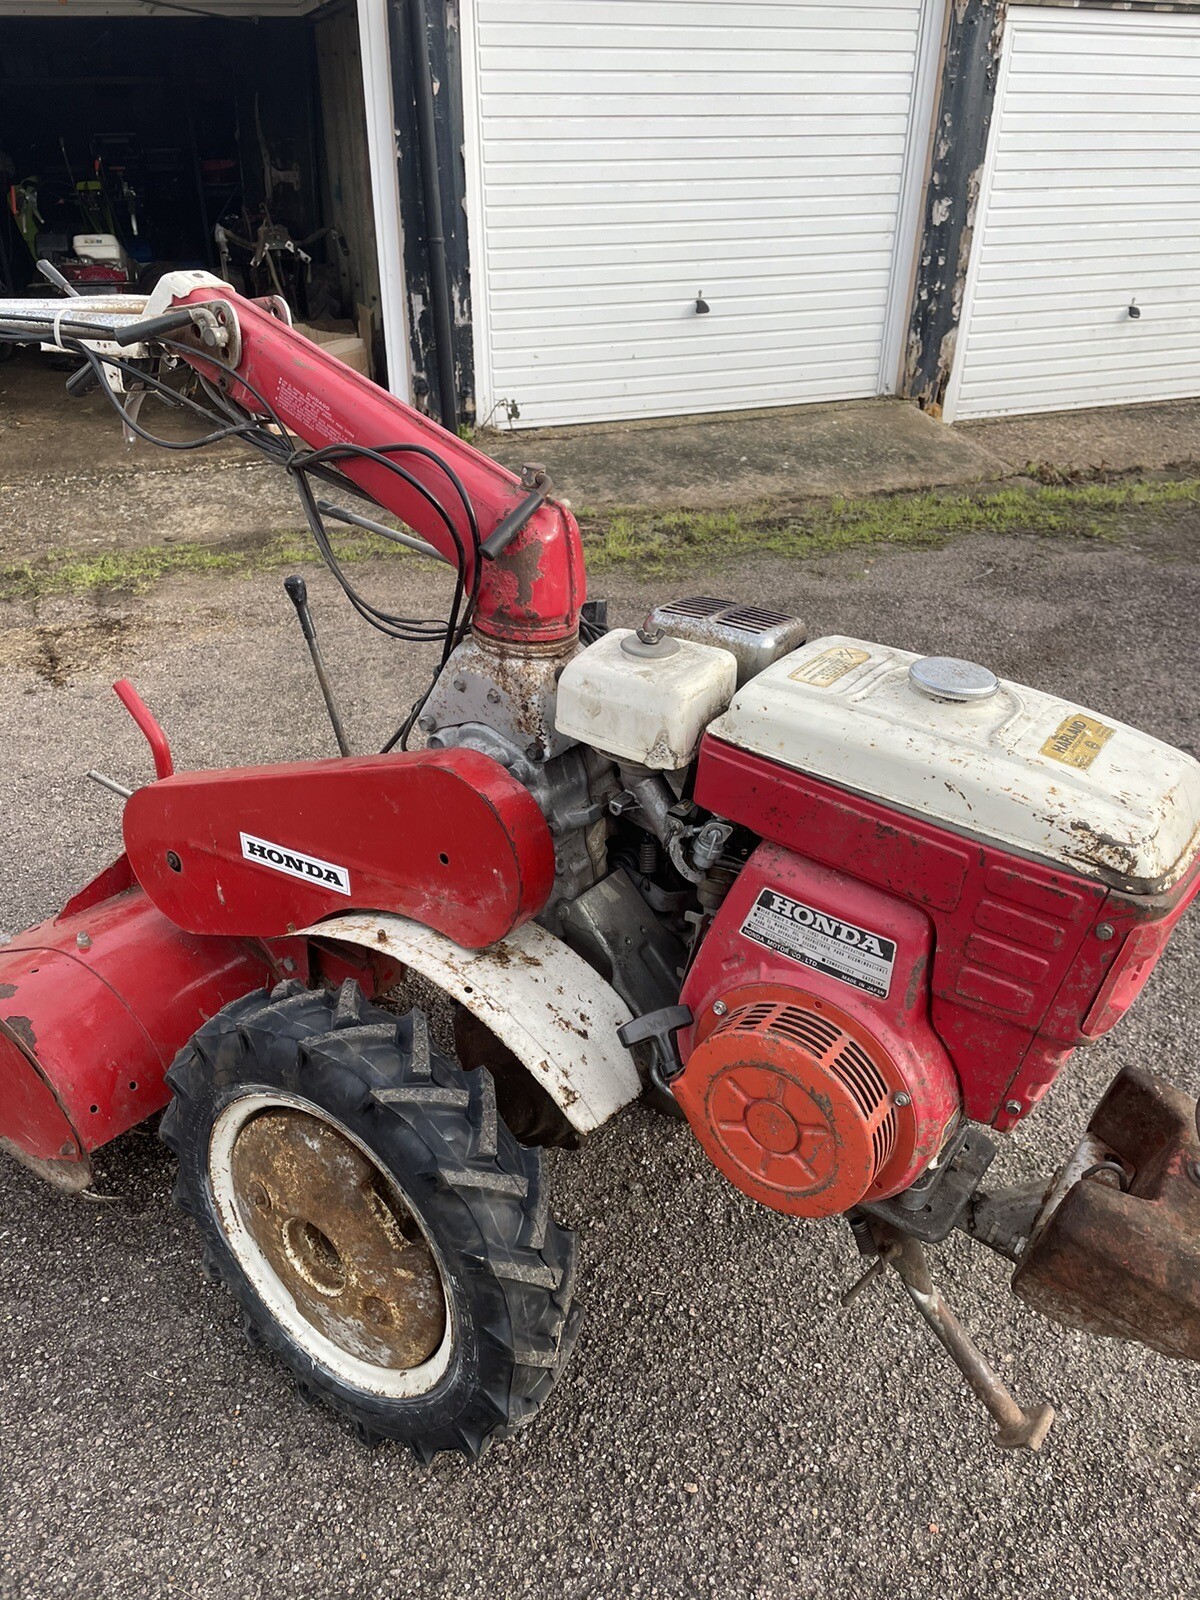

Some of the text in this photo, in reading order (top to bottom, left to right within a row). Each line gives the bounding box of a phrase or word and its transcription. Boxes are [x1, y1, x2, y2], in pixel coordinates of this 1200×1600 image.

[306, 391, 330, 411] CUIDADO
[1051, 720, 1087, 755] HARLAND
[246, 841, 344, 887] HONDA
[769, 894, 884, 957] HONDA
[743, 928, 765, 942] HONDA
[767, 939, 789, 954] MOTOR
[841, 974, 857, 985] MADE
[866, 985, 884, 996] JAPAN
